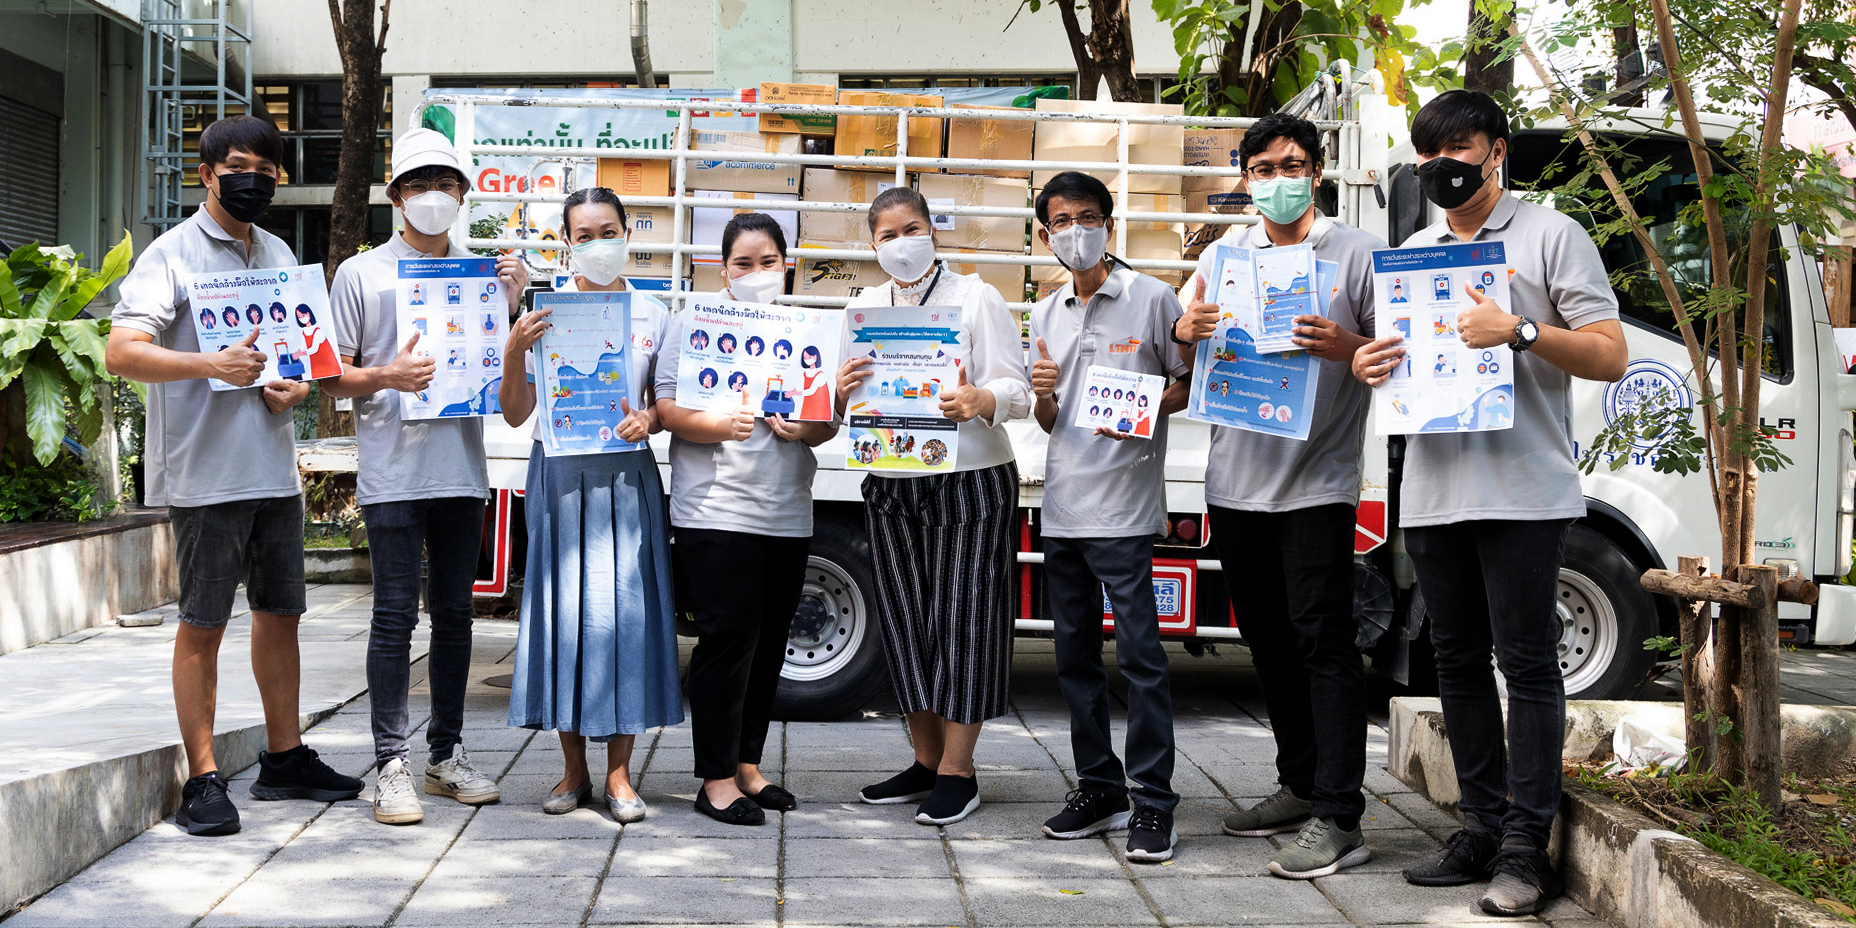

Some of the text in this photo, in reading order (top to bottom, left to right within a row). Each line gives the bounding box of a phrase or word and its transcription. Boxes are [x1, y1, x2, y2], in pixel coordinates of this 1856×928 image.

[725, 160, 776, 170] acommerce
[477, 167, 562, 193] Gree
[694, 304, 701, 312] 6
[1760, 417, 1796, 429] LR
